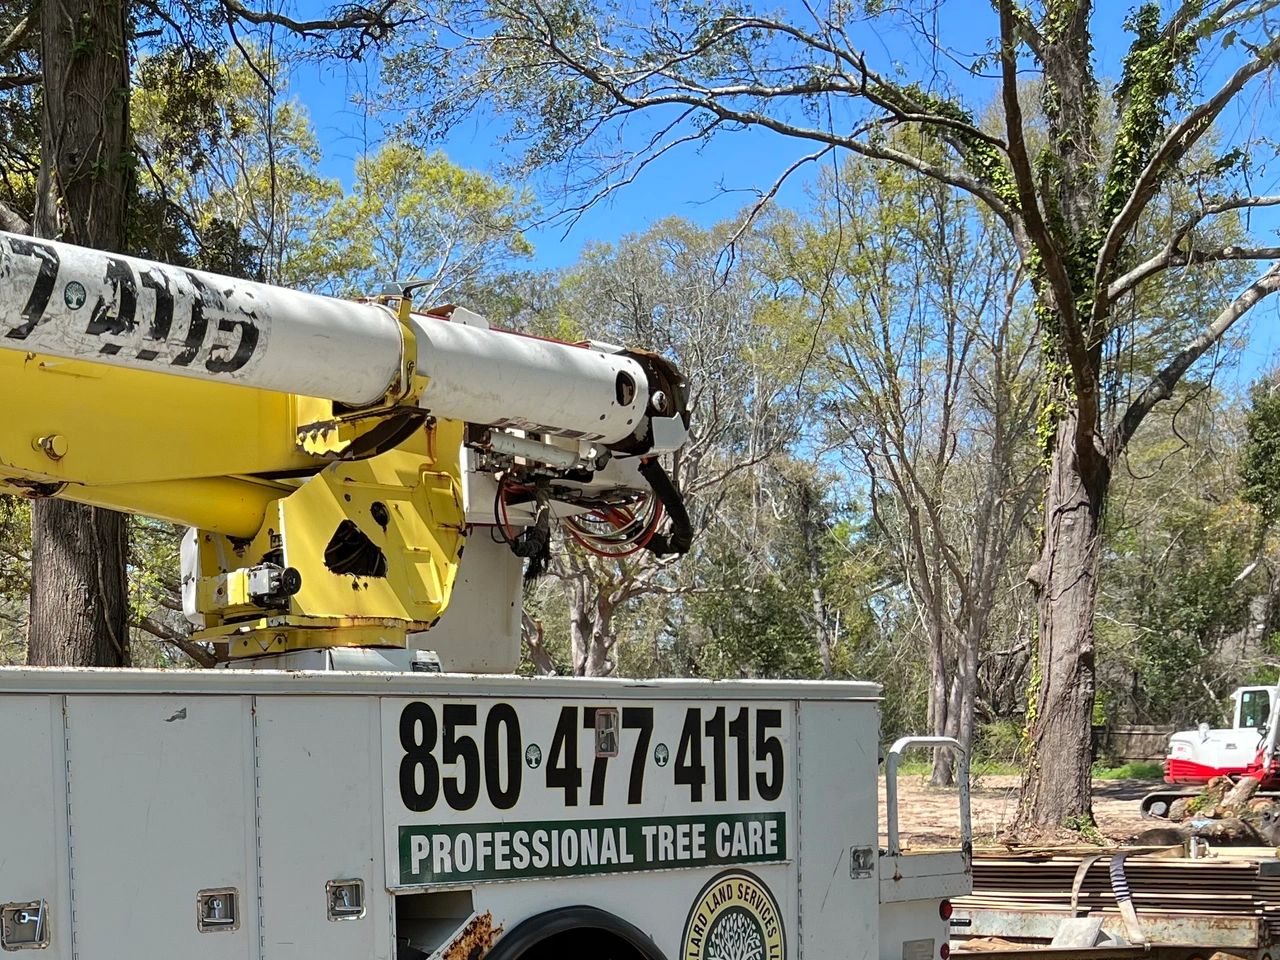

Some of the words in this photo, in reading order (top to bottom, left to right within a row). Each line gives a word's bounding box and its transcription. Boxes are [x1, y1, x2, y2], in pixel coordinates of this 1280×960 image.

[399, 702, 521, 812] 850
[546, 706, 654, 807] 477
[674, 707, 784, 803] 4115
[409, 827, 634, 875] PROFESSIONAL
[642, 823, 707, 862] TREE
[715, 820, 779, 859] CARE
[705, 884, 733, 914] LAND
[737, 883, 778, 938] SERVICES
